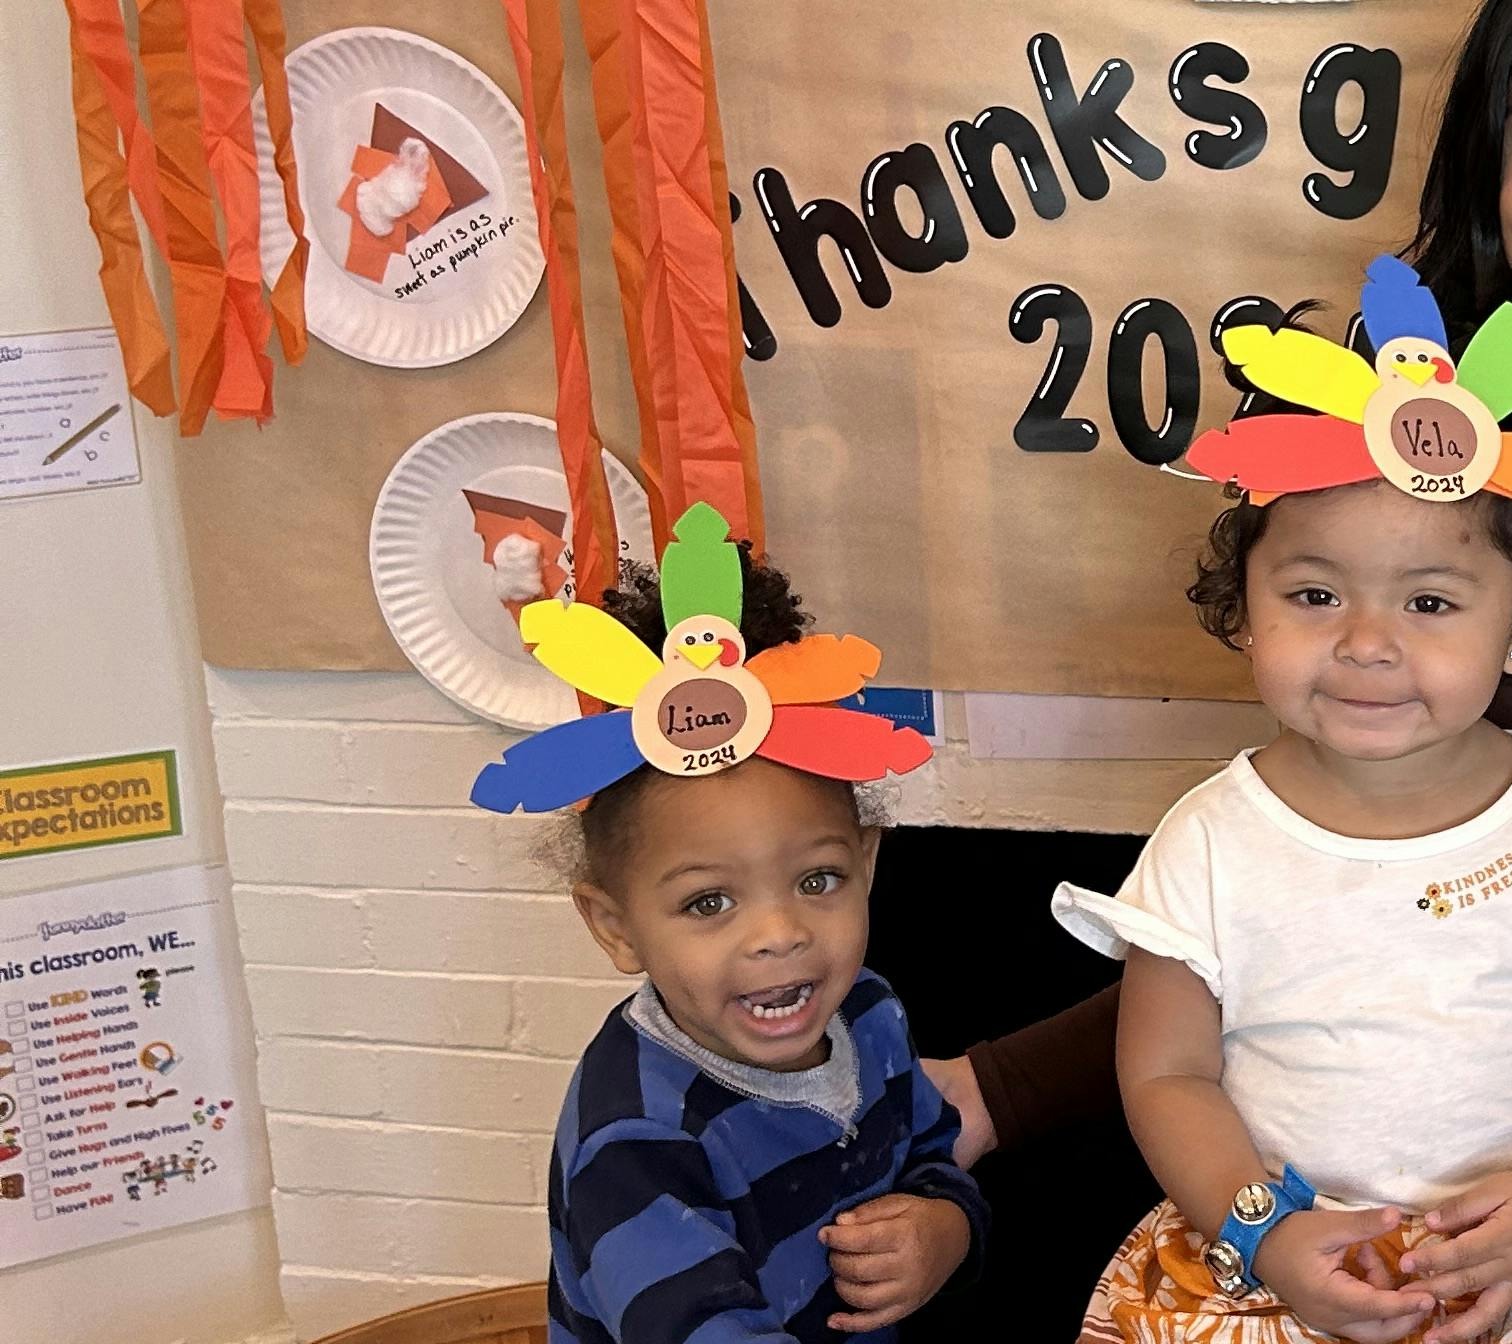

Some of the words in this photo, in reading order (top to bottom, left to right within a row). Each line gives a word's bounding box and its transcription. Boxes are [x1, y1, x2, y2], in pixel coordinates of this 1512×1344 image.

[408, 238, 449, 269] Liam
[448, 228, 468, 244] is
[469, 214, 492, 232] as
[394, 271, 428, 298] sweet
[430, 265, 446, 278] as
[449, 229, 498, 272] pumpkin
[1402, 418, 1464, 459] Vela
[1411, 474, 1465, 494] 2024
[667, 704, 731, 736] Liam
[682, 744, 738, 772] 2024
[0, 777, 151, 814] lassroom
[1458, 893, 1476, 908] IS
[30, 942, 144, 976] classroom,
[148, 931, 196, 953] WE...
[28, 1001, 49, 1012] Use
[91, 985, 128, 1000] Words
[31, 1019, 51, 1031] Use
[53, 1012, 88, 1026] Inside
[91, 1004, 130, 1018] Voices
[33, 1038, 54, 1049] Use
[56, 1028, 101, 1045] Helping
[103, 1021, 138, 1035] Hands
[36, 1057, 57, 1067] Use
[59, 1048, 98, 1063] Gentle
[100, 1040, 136, 1055] Hands
[46, 1129, 74, 1142] Take
[76, 1121, 108, 1135] Turns
[54, 1182, 92, 1197] Dance
[56, 1201, 88, 1215] Have
